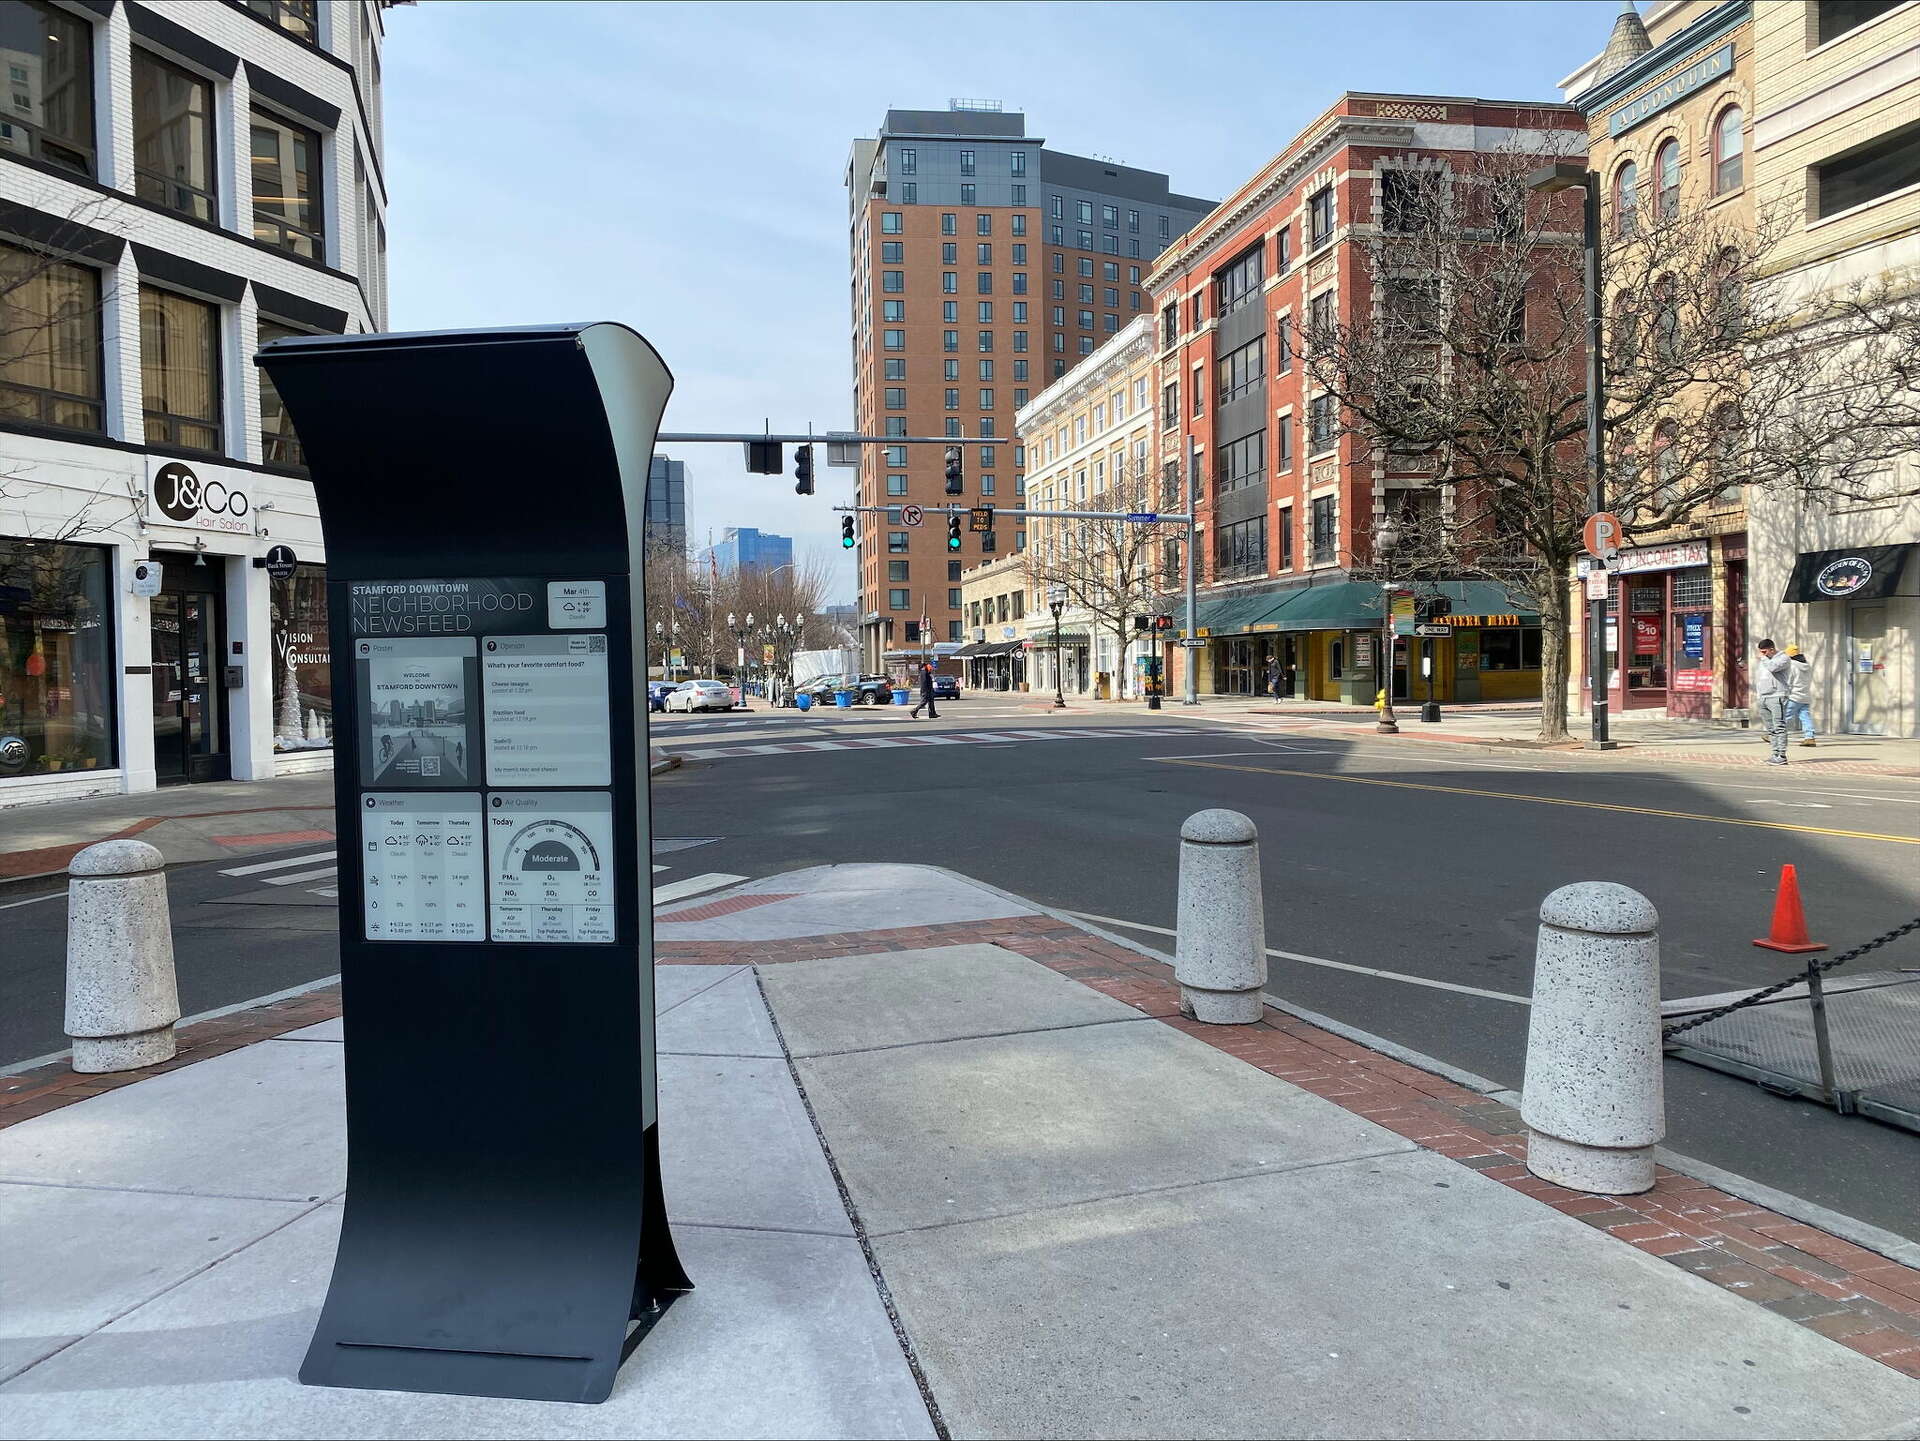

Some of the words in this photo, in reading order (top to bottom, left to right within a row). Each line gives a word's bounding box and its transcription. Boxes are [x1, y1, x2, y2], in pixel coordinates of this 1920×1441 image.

[1618, 55, 1721, 129] ALGONQUIN
[167, 474, 248, 517] J&Co
[196, 516, 215, 527] Hair
[219, 518, 248, 531] Salon
[1596, 521, 1614, 550] P
[275, 547, 284, 562] 1
[1636, 548, 1678, 567] INCOME
[1681, 544, 1704, 564] TAX
[1822, 560, 1849, 579] GARDEN
[352, 585, 406, 595] STAMFORD
[409, 584, 469, 593] DOWNTOWN
[353, 593, 533, 613] NEIGHBORHOOD
[353, 615, 471, 632] NEWSFEED
[1488, 614, 1519, 626] MAYA
[276, 633, 313, 659] VISION
[515, 799, 538, 807] Quality
[492, 818, 513, 826] Today
